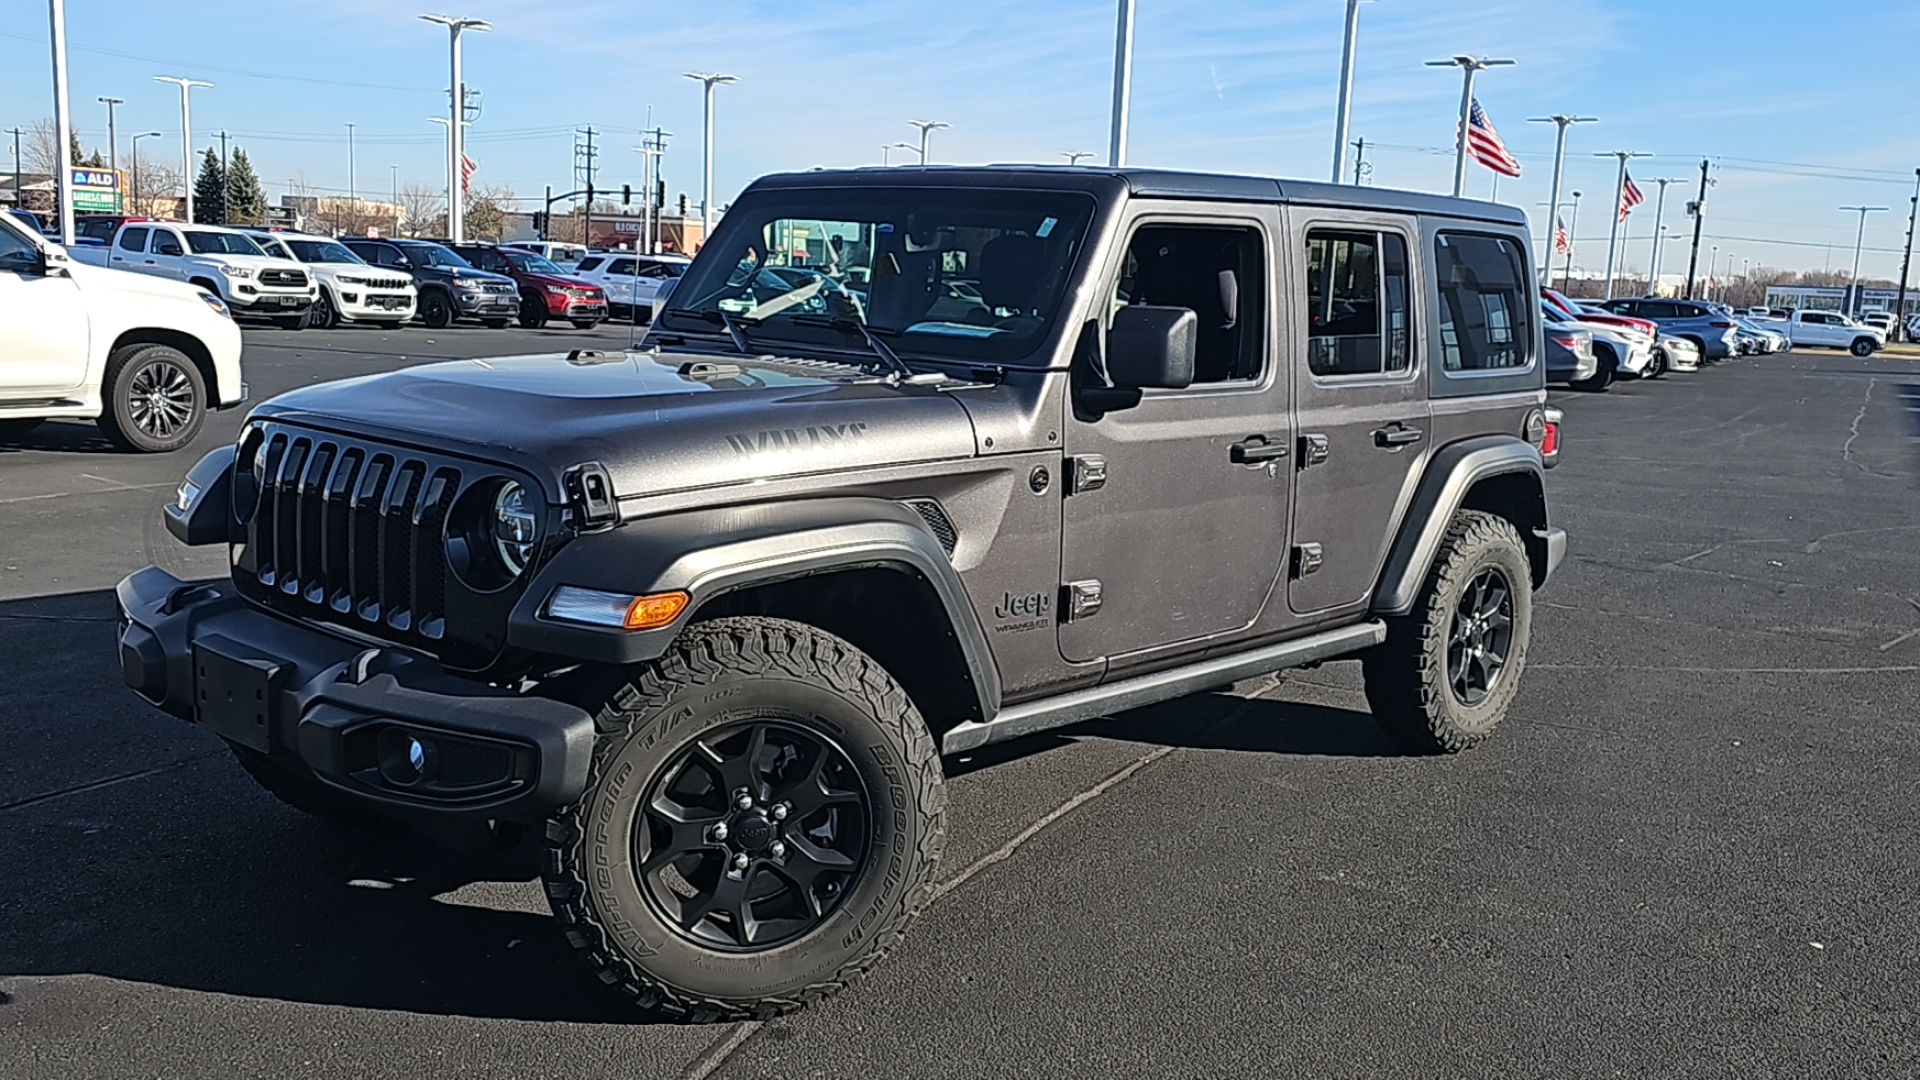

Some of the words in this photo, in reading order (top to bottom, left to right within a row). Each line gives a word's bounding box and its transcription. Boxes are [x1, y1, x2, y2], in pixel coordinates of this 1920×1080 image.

[87, 173, 116, 185] ALD
[994, 591, 1049, 619] Jeep
[994, 619, 1049, 633] WRANGLER
[594, 759, 660, 958] All-Terrain
[841, 743, 907, 950] BFGoodrich
